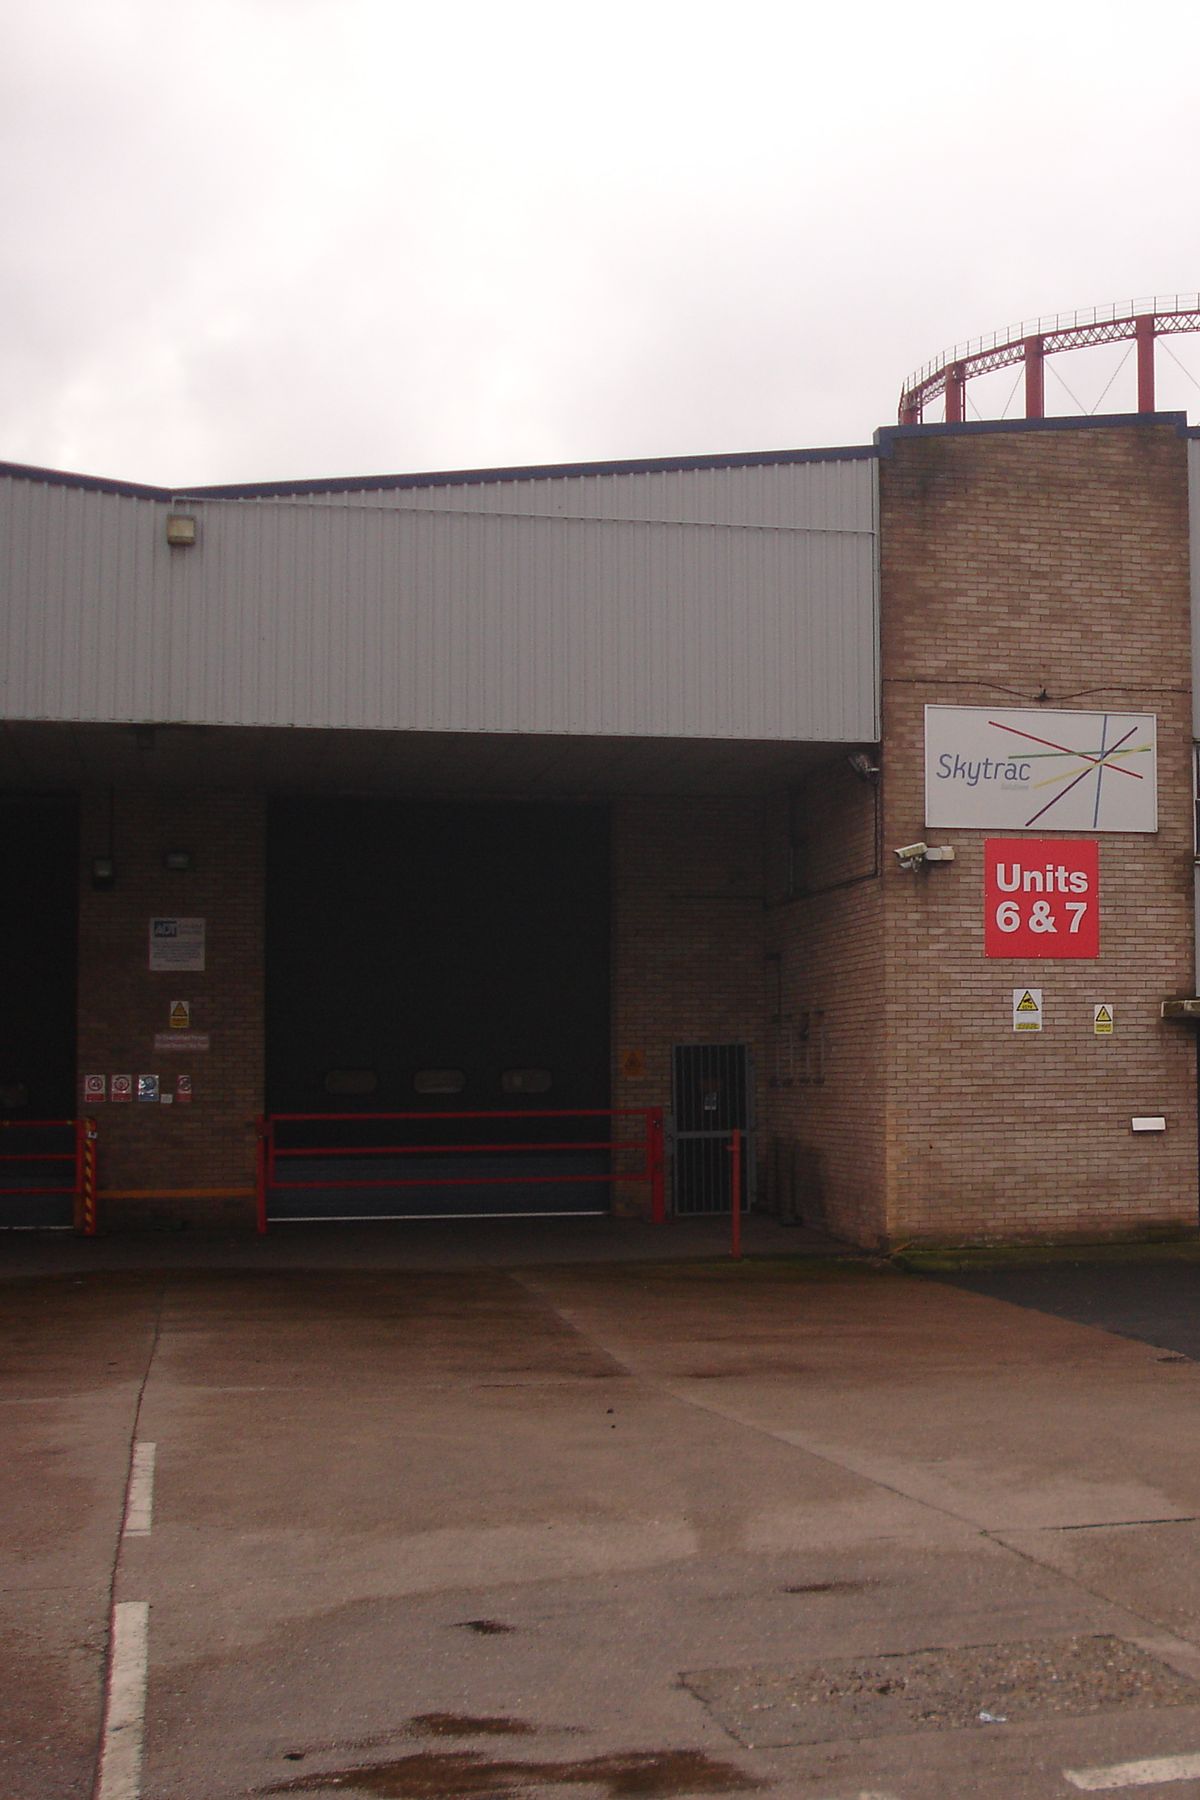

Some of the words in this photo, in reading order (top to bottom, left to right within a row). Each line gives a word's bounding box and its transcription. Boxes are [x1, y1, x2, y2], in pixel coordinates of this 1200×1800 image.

[936, 753, 1031, 786] Skytrac
[996, 863, 1089, 893] Units
[995, 901, 1021, 933] 6
[1028, 900, 1057, 933] &
[1065, 902, 1088, 933] 7
